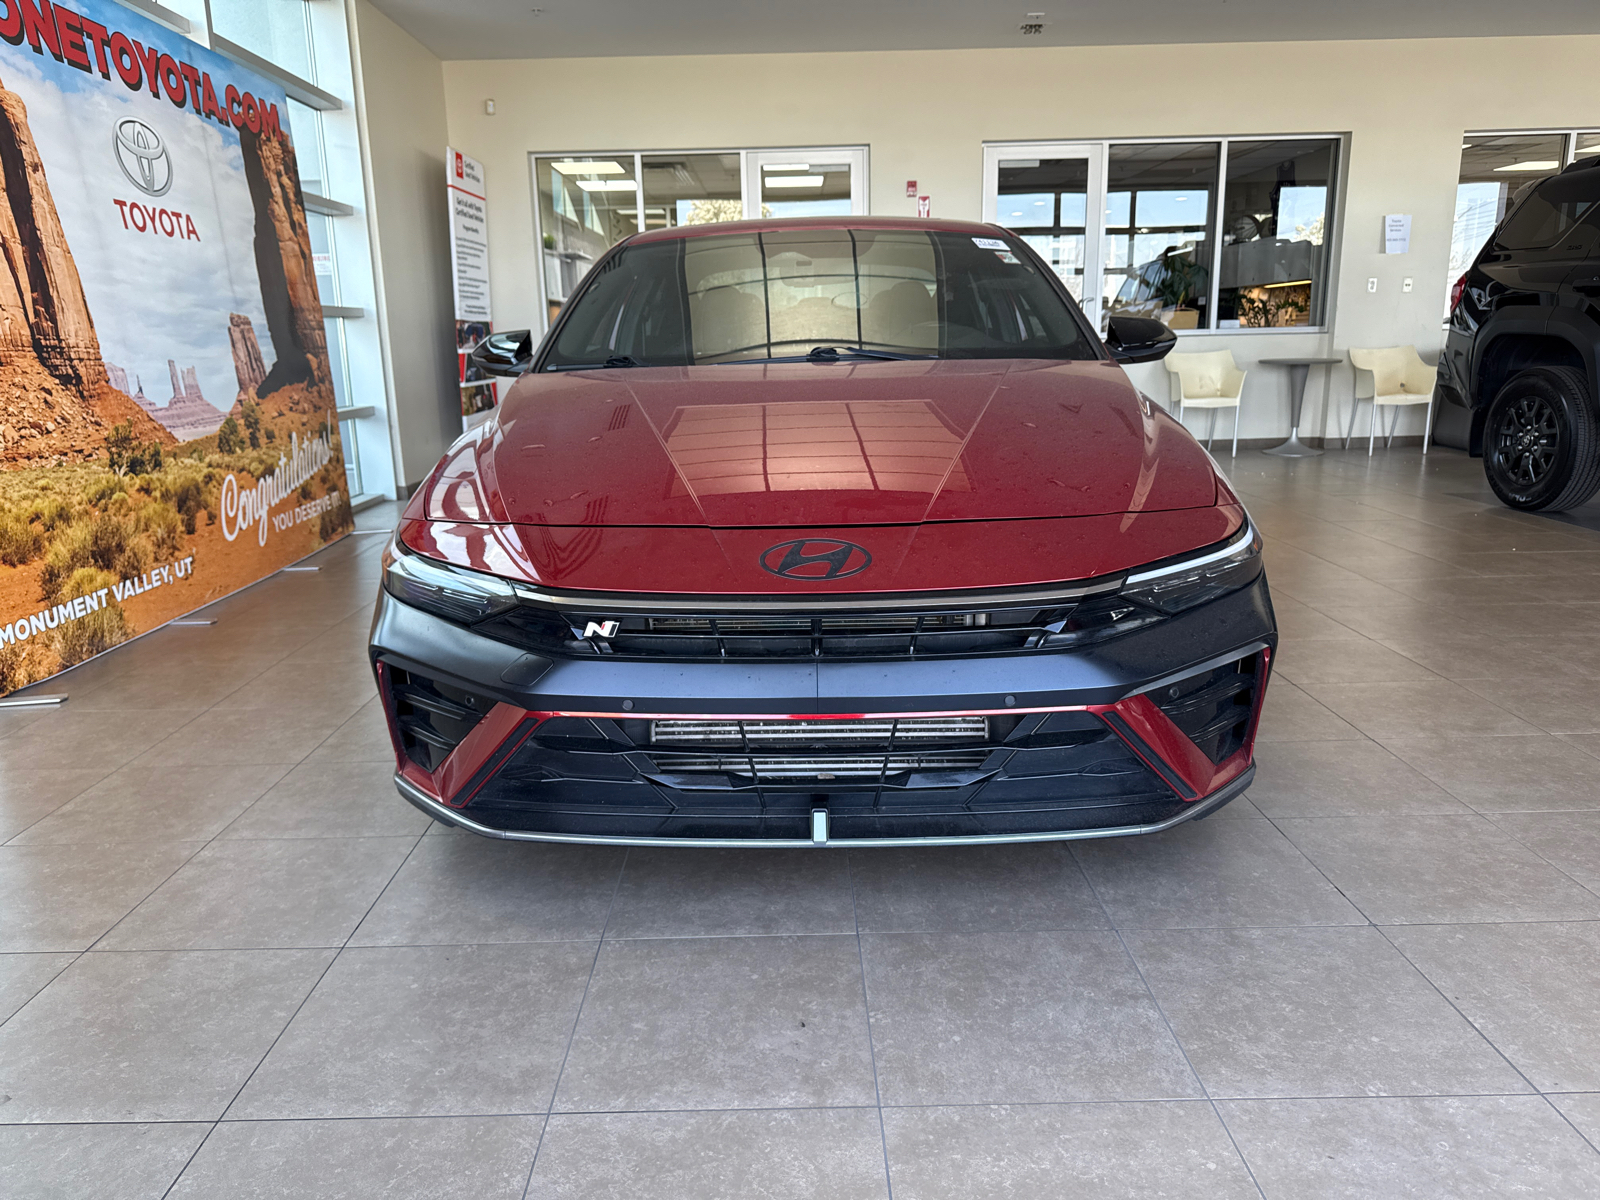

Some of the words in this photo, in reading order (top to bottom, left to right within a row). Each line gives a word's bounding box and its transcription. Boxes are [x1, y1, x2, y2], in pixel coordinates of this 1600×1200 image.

[113, 198, 201, 242] TOYOTA
[272, 510, 294, 533] YOU
[294, 495, 332, 524] DESERVE
[0, 587, 109, 649] MONUMENT
[111, 563, 174, 602] VALLEY,
[174, 556, 194, 580] UT
